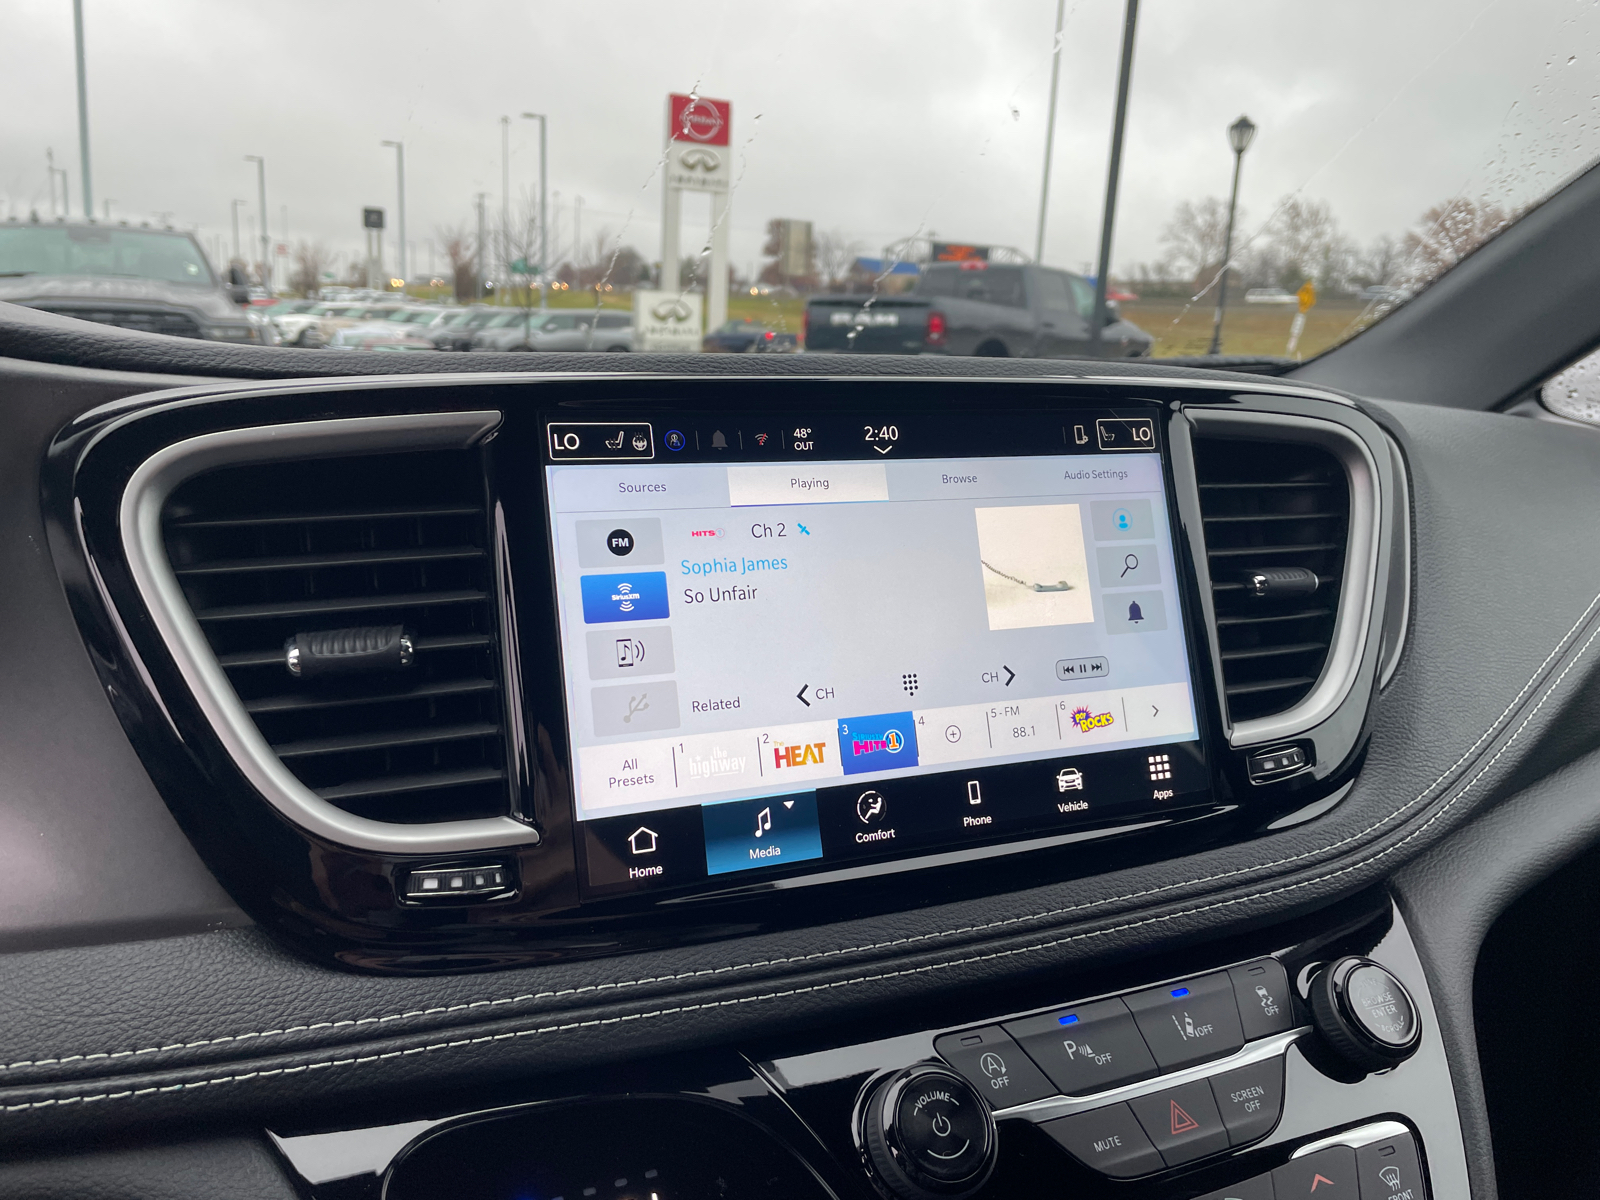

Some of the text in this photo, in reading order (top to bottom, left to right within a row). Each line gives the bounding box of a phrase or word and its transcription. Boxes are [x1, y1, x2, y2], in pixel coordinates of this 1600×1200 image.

[793, 427, 812, 439] 48°
[863, 426, 899, 441] 2:40
[1132, 427, 1150, 441] LO
[553, 433, 580, 450] LO
[794, 441, 814, 451] OUT
[941, 473, 978, 484] Browse
[1063, 468, 1128, 481] Audio Settings
[618, 481, 667, 493] Sources
[790, 477, 829, 490] Playing
[751, 523, 787, 538] Ch 2
[612, 537, 629, 548] FM
[681, 556, 788, 577] Sophia James
[684, 585, 758, 604] So Unfair
[981, 671, 999, 683] CH
[815, 687, 835, 700] CH
[692, 697, 741, 713] Related
[1060, 701, 1066, 711] 6
[918, 716, 925, 726] 4
[1080, 713, 1114, 732] ROCKS
[842, 724, 849, 735] 3
[1012, 726, 1036, 739] 88.1
[762, 733, 770, 744] 2
[678, 743, 684, 753] 1
[713, 747, 728, 758] the
[773, 742, 826, 769] HEAT
[622, 758, 638, 771] All
[688, 755, 746, 778] highway
[608, 773, 655, 789] Presets
[1152, 786, 1173, 800] Apps
[1057, 801, 1089, 813] Vehicle
[963, 814, 993, 828] Phone
[855, 829, 896, 844] Comfort
[749, 847, 781, 860] Media
[629, 864, 663, 879] Home
[1361, 991, 1395, 1007] BROWSE
[1264, 1005, 1280, 1017] OFF
[1371, 1004, 1398, 1018] ENTER
[1198, 1023, 1214, 1037] OFF
[1094, 1052, 1113, 1066] OFF
[990, 1076, 1010, 1089] OFF
[914, 1090, 951, 1110] VOLUME
[1230, 1086, 1265, 1103] SCREEN
[1244, 1100, 1262, 1113] OFF
[1093, 1135, 1123, 1153] MUTE
